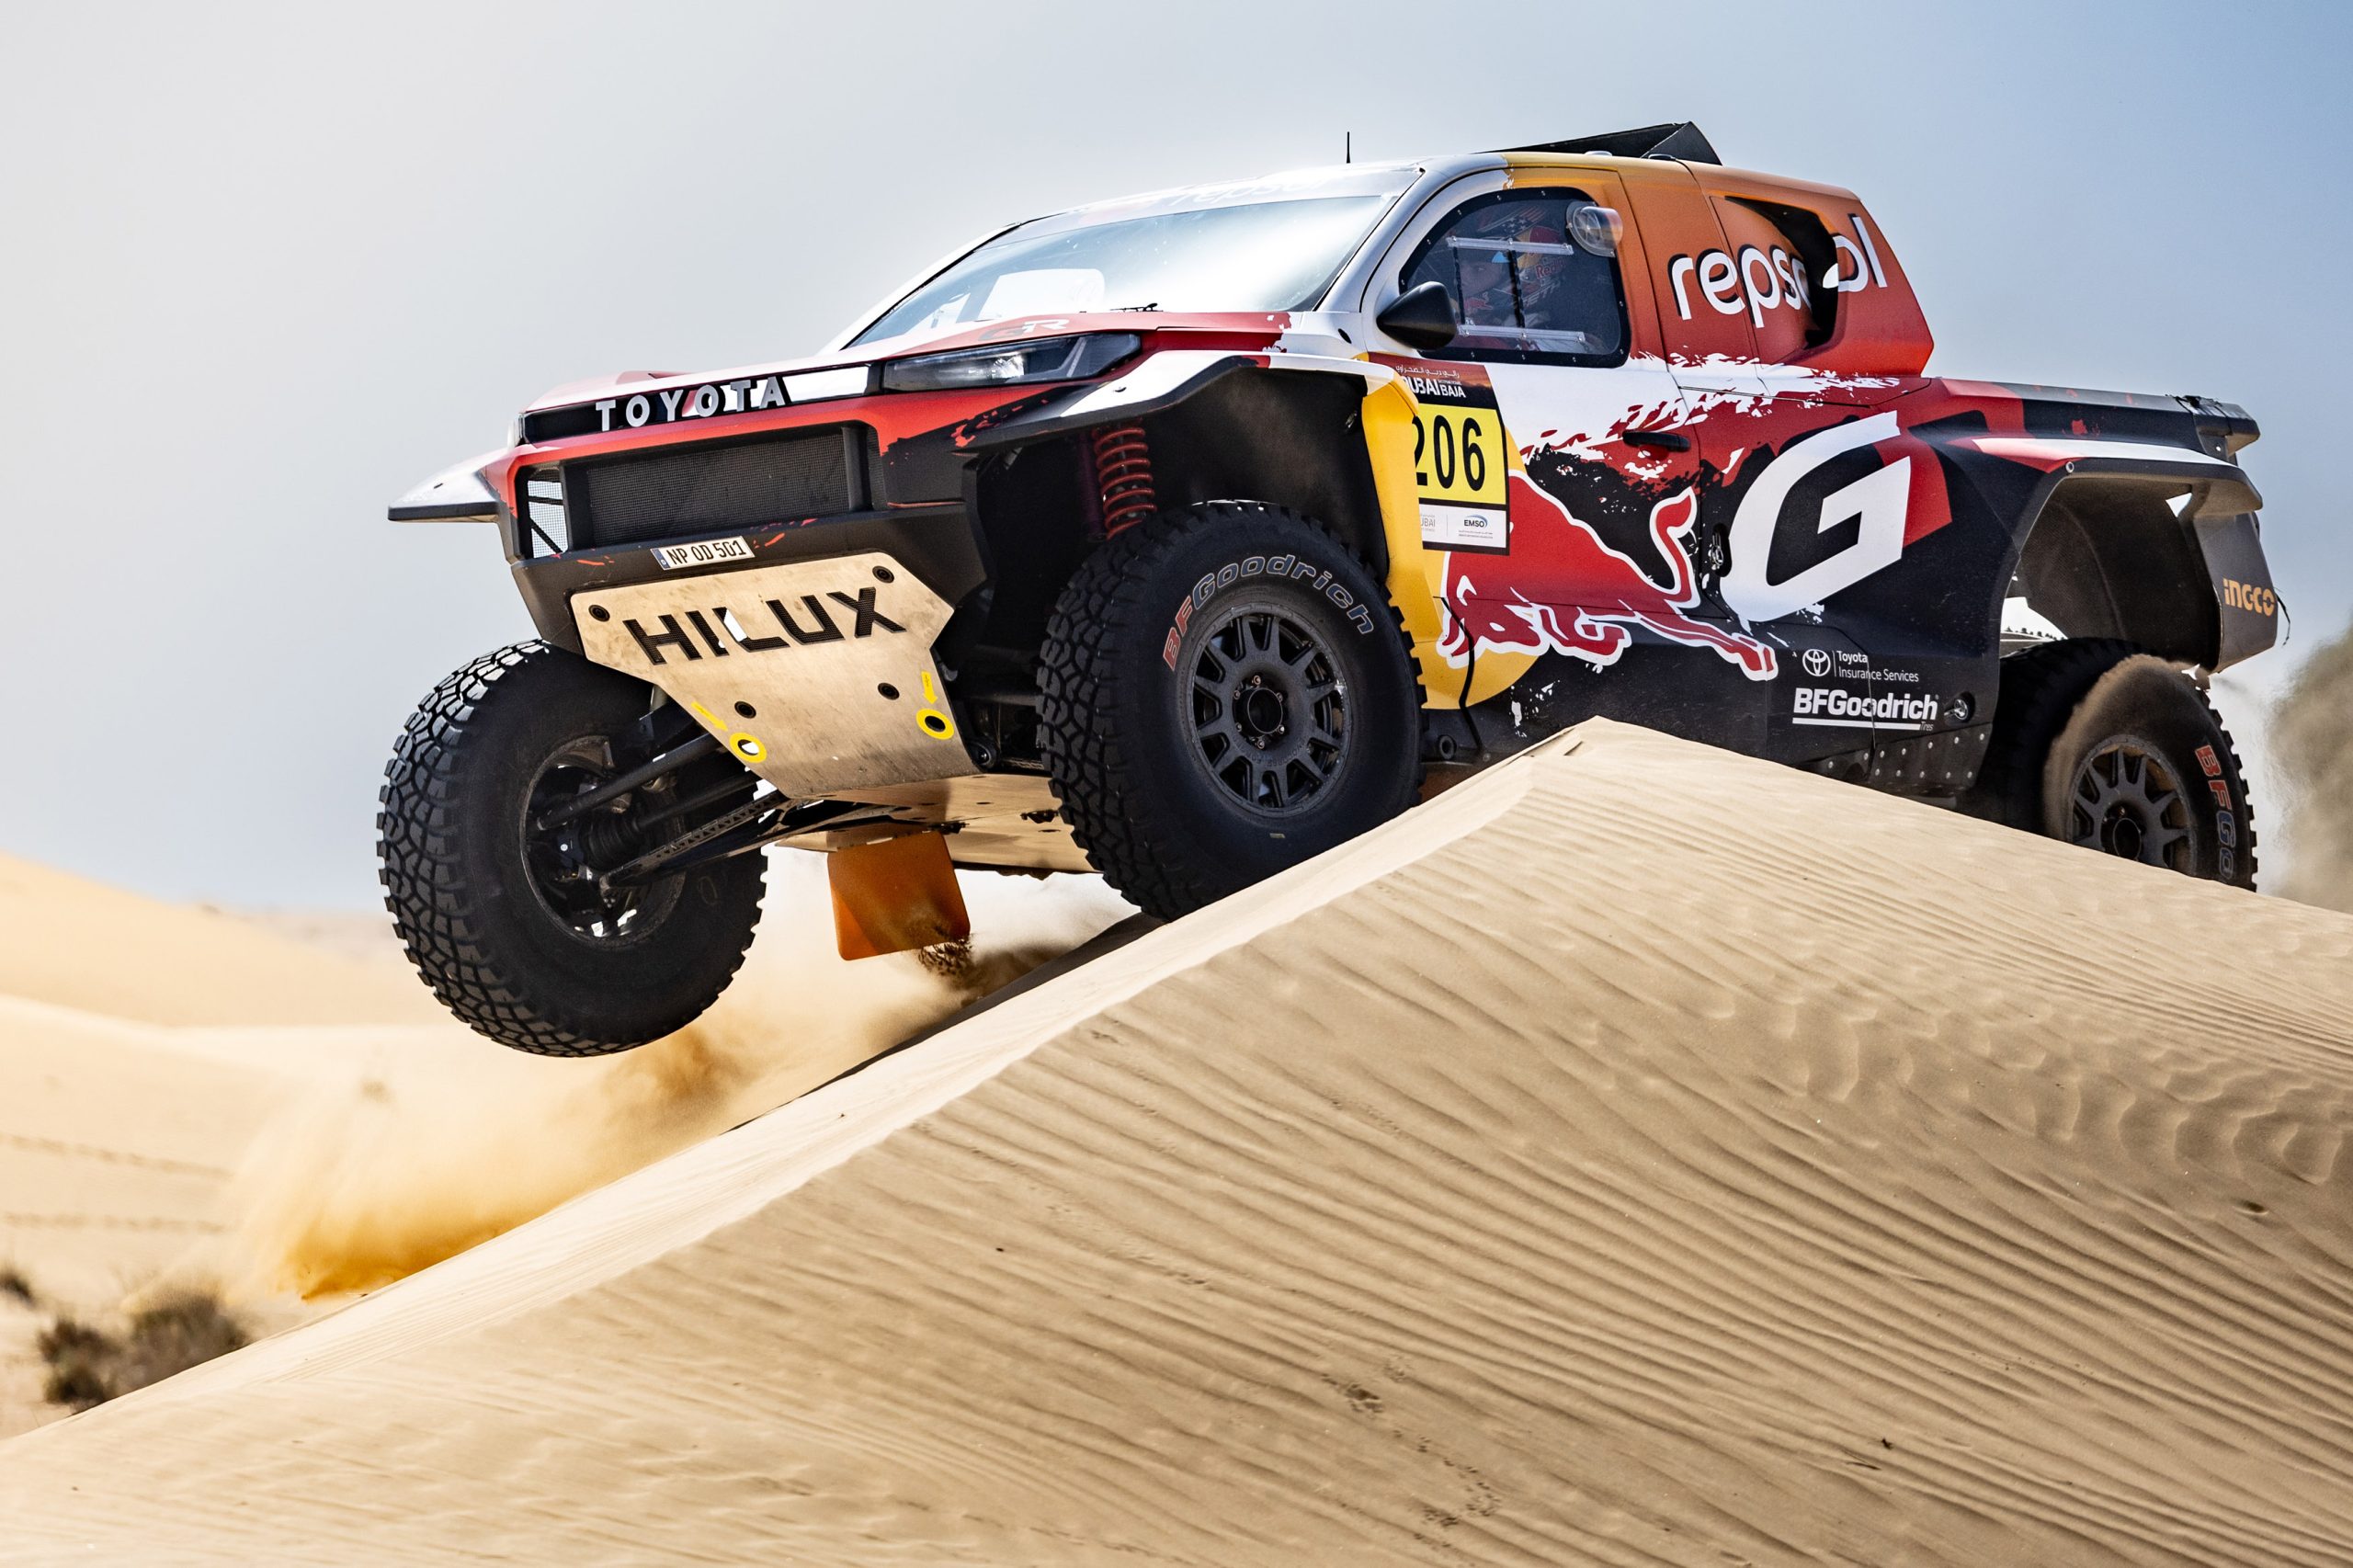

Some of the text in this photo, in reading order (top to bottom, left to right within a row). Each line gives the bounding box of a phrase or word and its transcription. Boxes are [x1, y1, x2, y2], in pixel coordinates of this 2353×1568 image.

[978, 318, 1070, 341] GR
[1439, 384, 1467, 399] BAJA
[596, 376, 785, 432] TOYOTA
[1463, 519, 1485, 528] EMSO
[665, 547, 688, 565] NP
[712, 540, 747, 558] 501
[1162, 554, 1374, 671] BFGoodrich
[623, 585, 906, 666] HILUX
[1836, 651, 1868, 665] Toyota
[1838, 666, 1919, 683] Insurance Services
[1793, 687, 1938, 720] BFGoodrich
